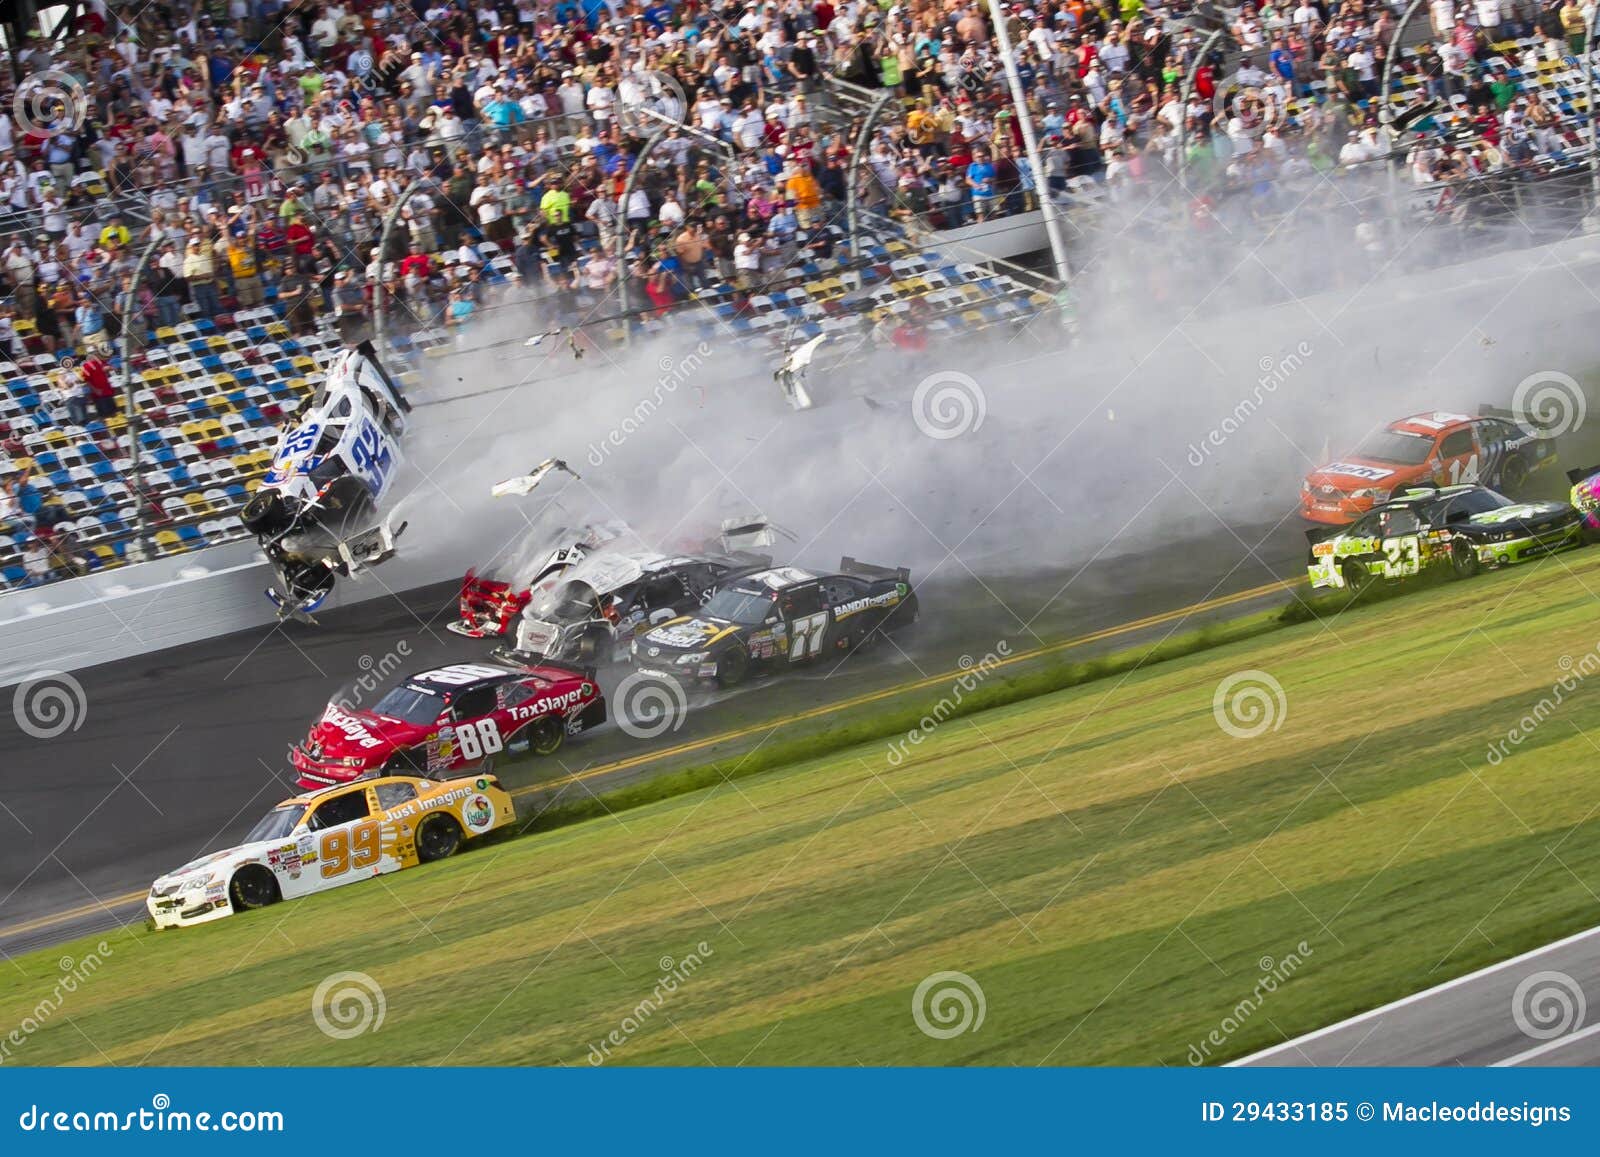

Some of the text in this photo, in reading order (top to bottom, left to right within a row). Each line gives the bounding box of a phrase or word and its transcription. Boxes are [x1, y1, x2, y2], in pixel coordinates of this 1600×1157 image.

[1383, 536, 1420, 579] 23
[789, 611, 829, 662] 77
[507, 687, 582, 721] TaxSlayer
[455, 717, 503, 761] 88
[385, 786, 473, 823] Just Imagine
[320, 820, 382, 879] 99
